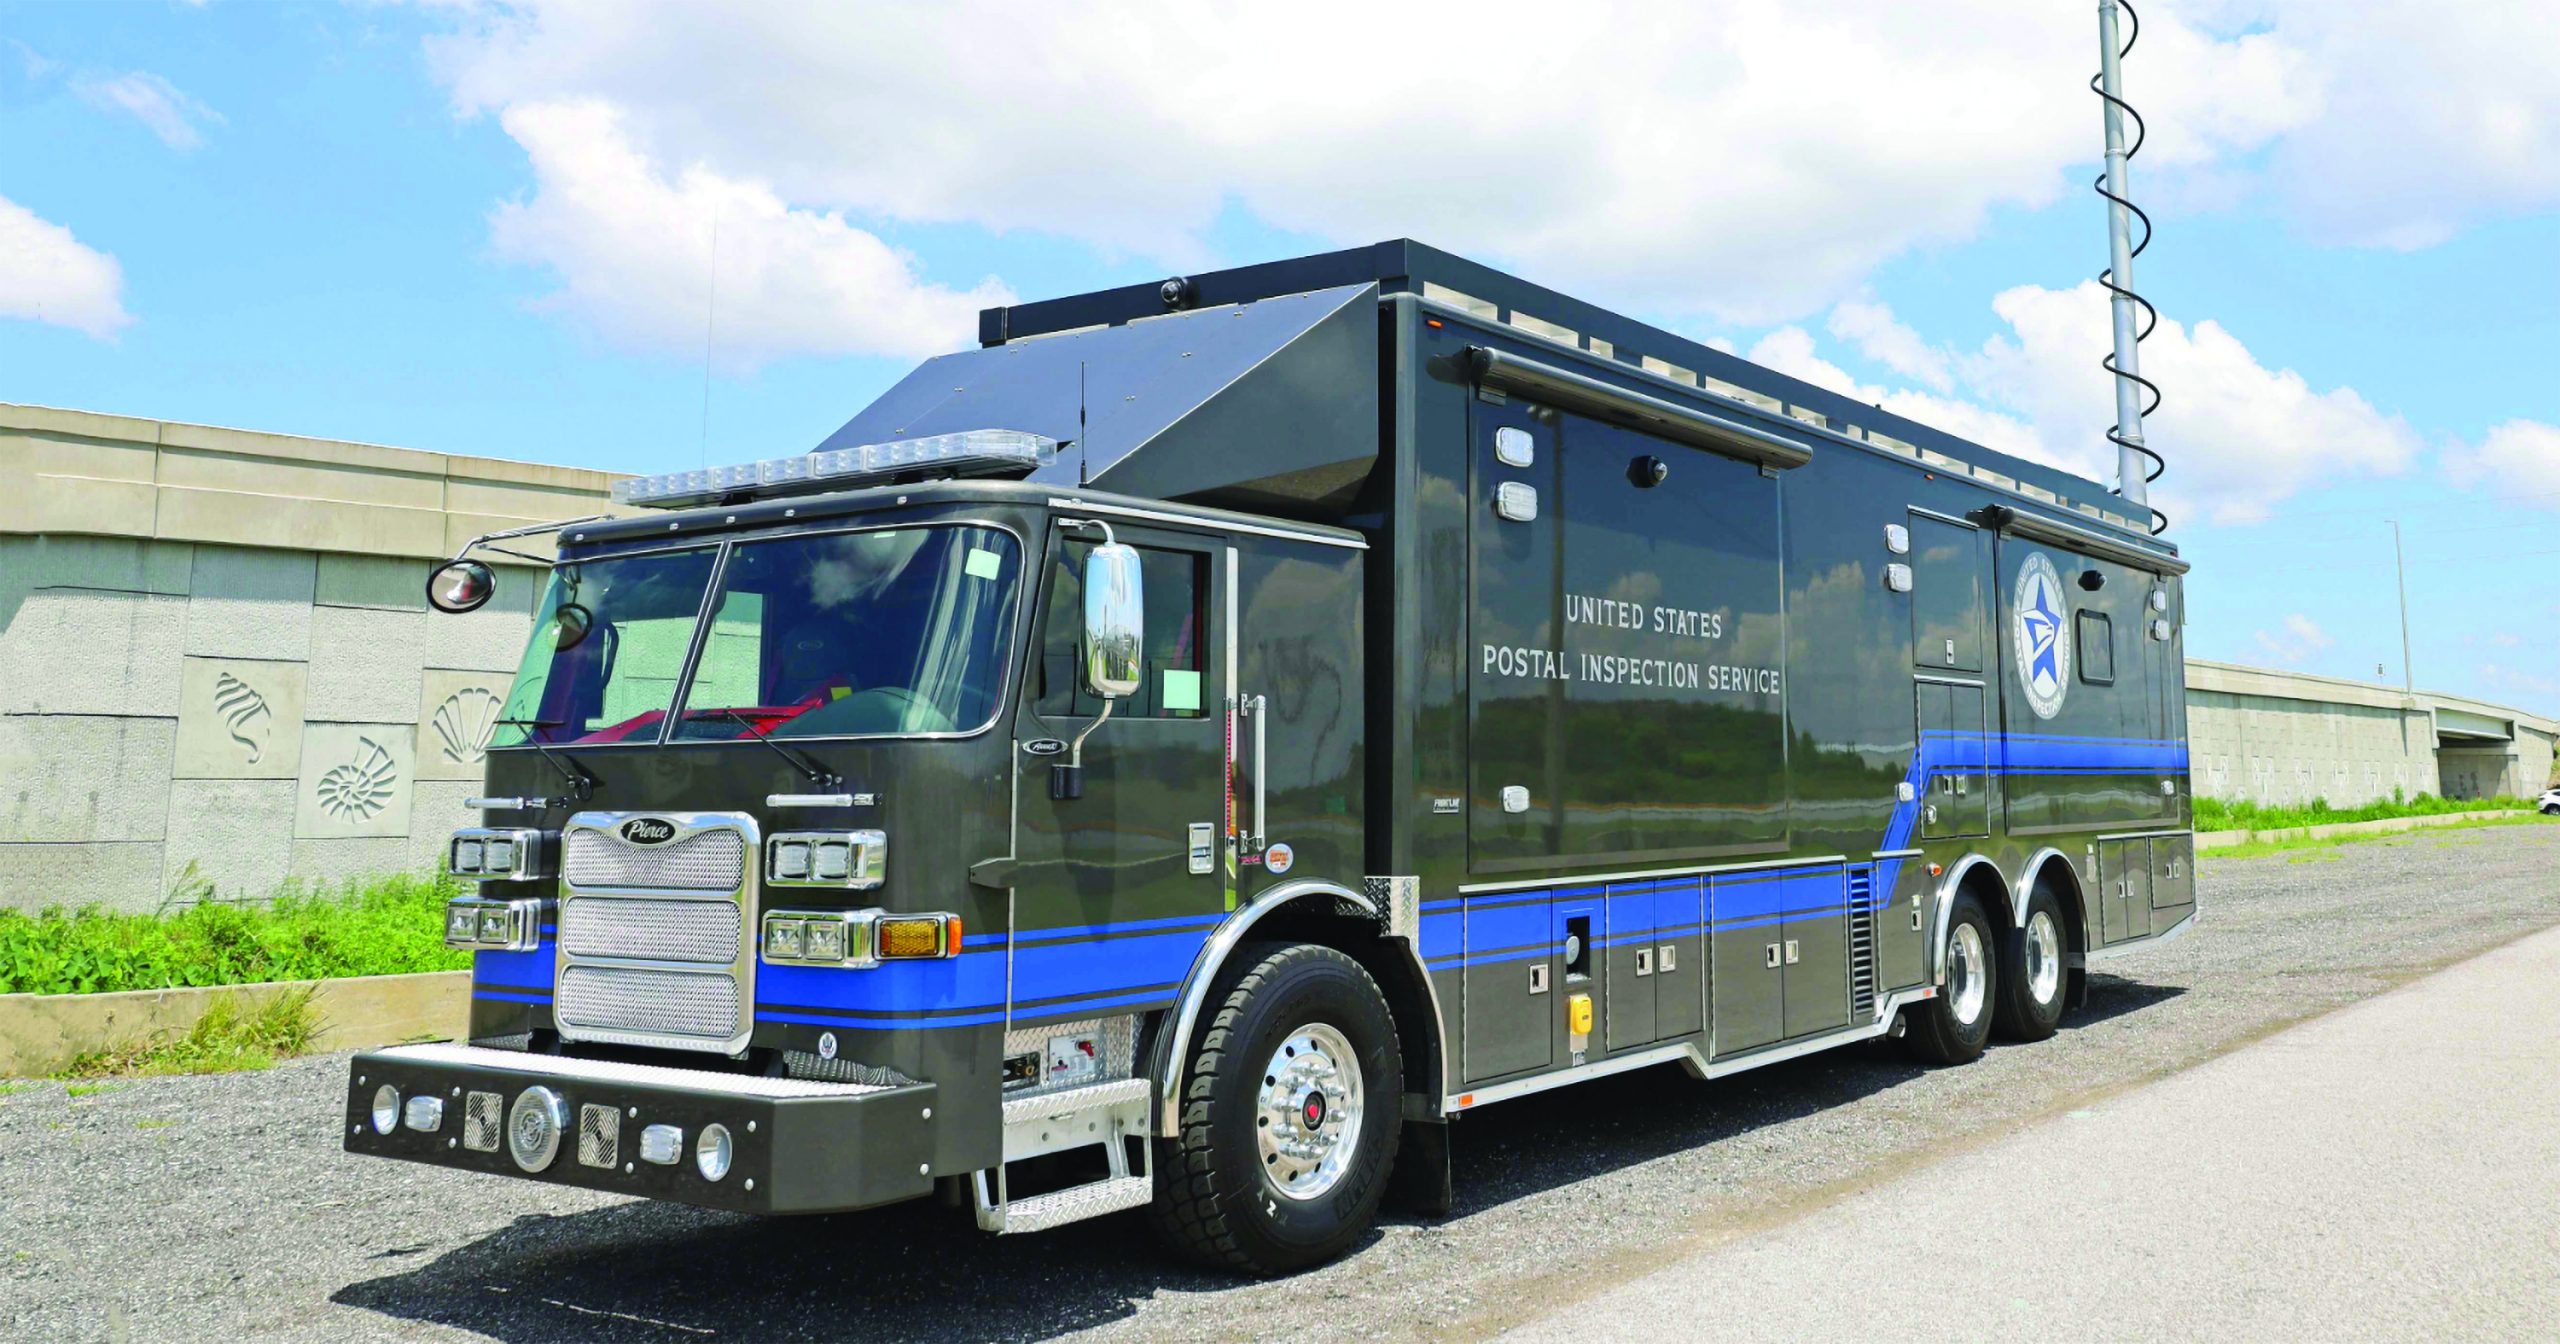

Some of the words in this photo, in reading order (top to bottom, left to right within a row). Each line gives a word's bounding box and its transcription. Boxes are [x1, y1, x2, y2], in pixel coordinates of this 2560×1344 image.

[1565, 594, 1643, 630] UNITED
[1653, 606, 1722, 639] STATES
[1483, 644, 1571, 680] POSTAL
[1581, 653, 1699, 689] INSPECTION
[1708, 665, 1780, 695] SERVICE
[627, 820, 669, 841] Pierce
